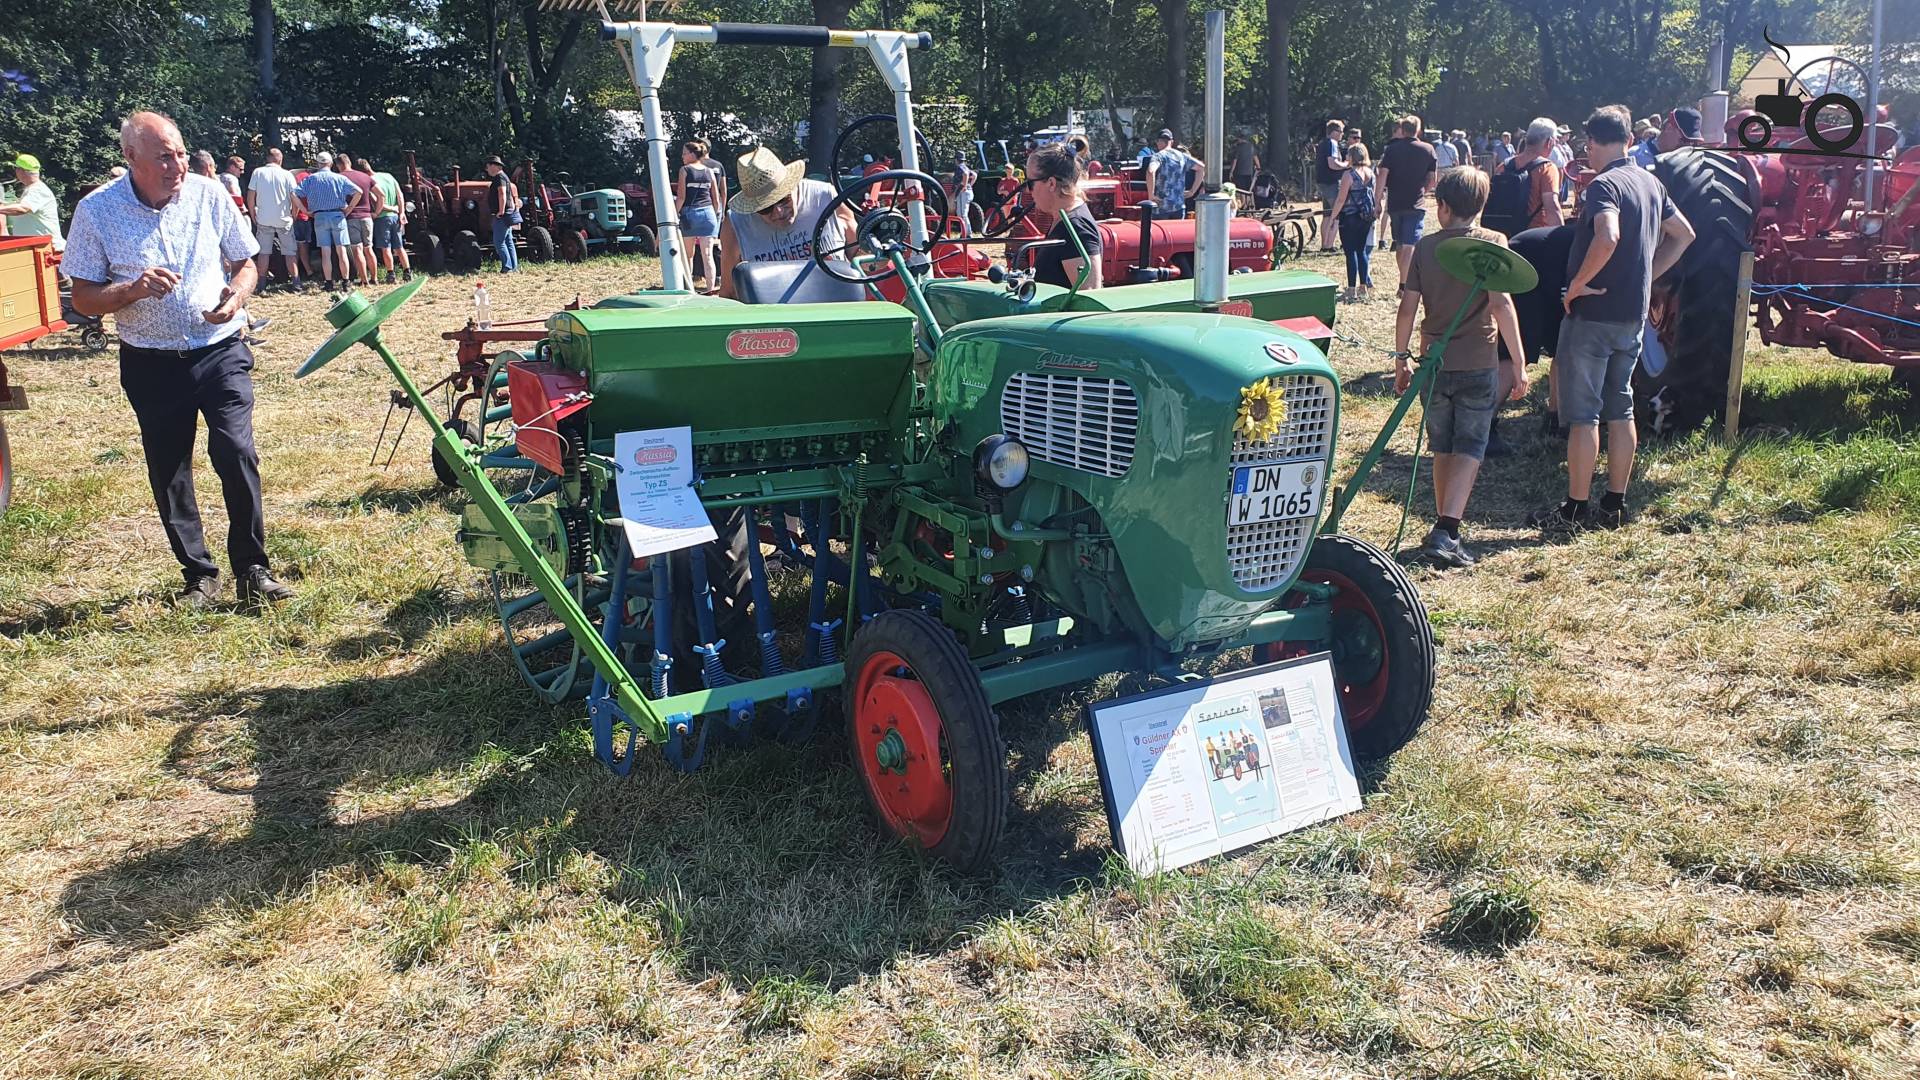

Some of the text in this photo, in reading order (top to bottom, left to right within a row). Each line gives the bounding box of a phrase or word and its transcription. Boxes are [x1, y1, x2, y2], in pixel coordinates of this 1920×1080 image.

[737, 334, 791, 351] Hassia
[644, 481, 657, 489] Typ
[1252, 467, 1281, 493] DN
[1239, 492, 1312, 521] W 1065
[1199, 705, 1248, 721] Sprinter
